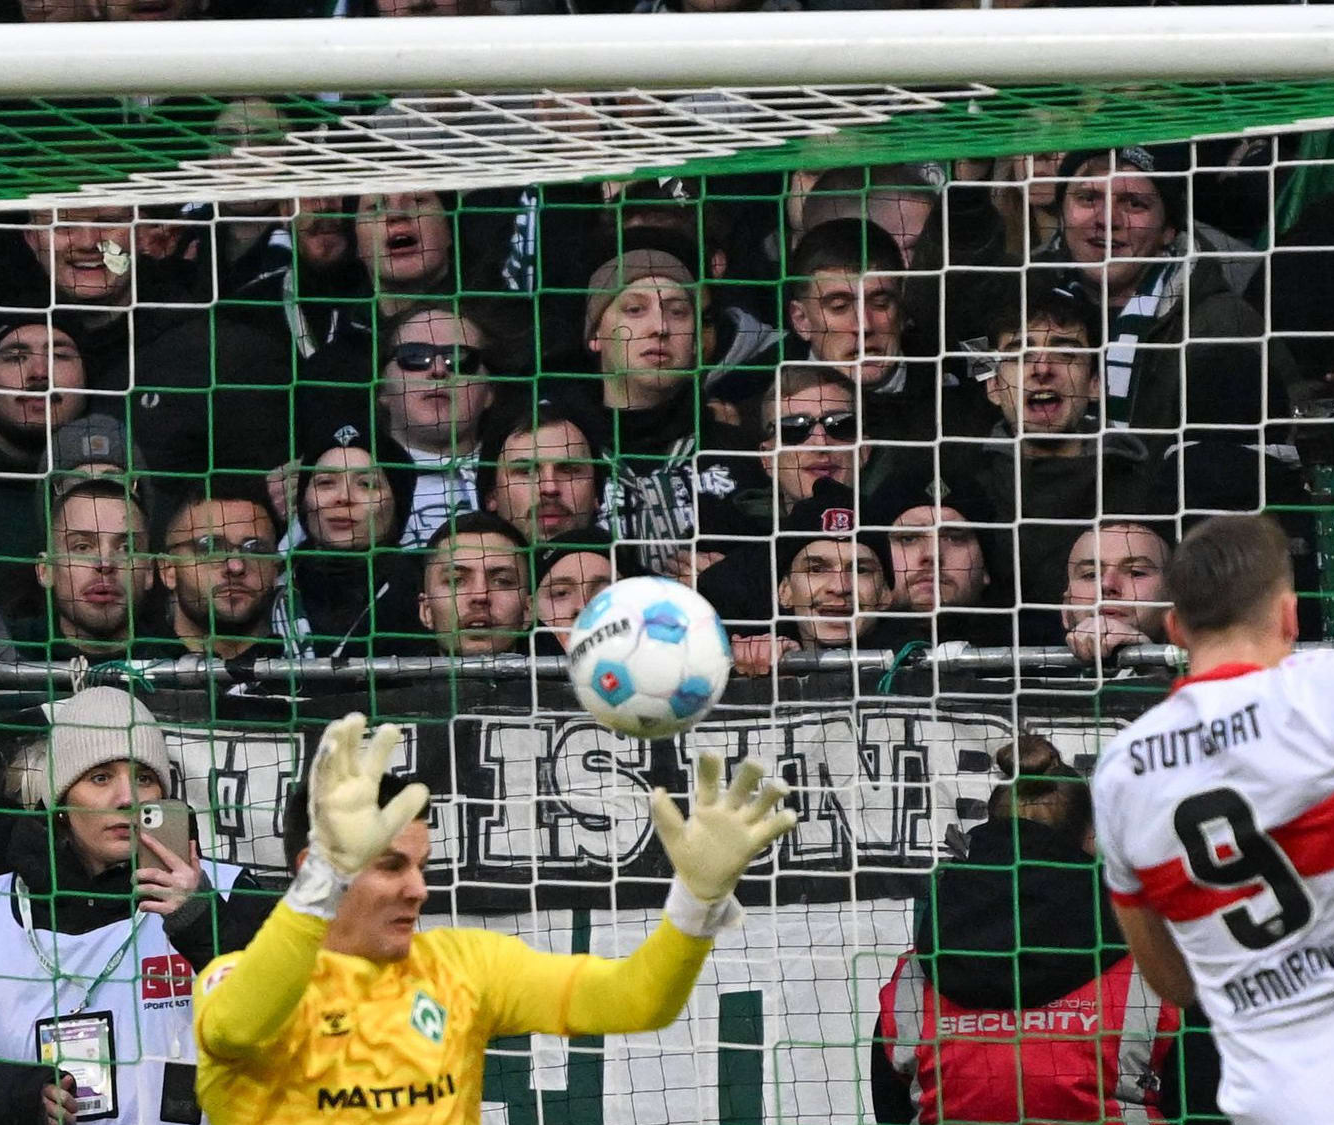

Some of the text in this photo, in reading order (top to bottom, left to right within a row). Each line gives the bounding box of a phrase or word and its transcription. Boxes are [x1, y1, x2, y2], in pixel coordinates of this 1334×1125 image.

[475, 716, 655, 868] IS
[1173, 786, 1315, 951] 9
[938, 1010, 1100, 1035] SECURITY
